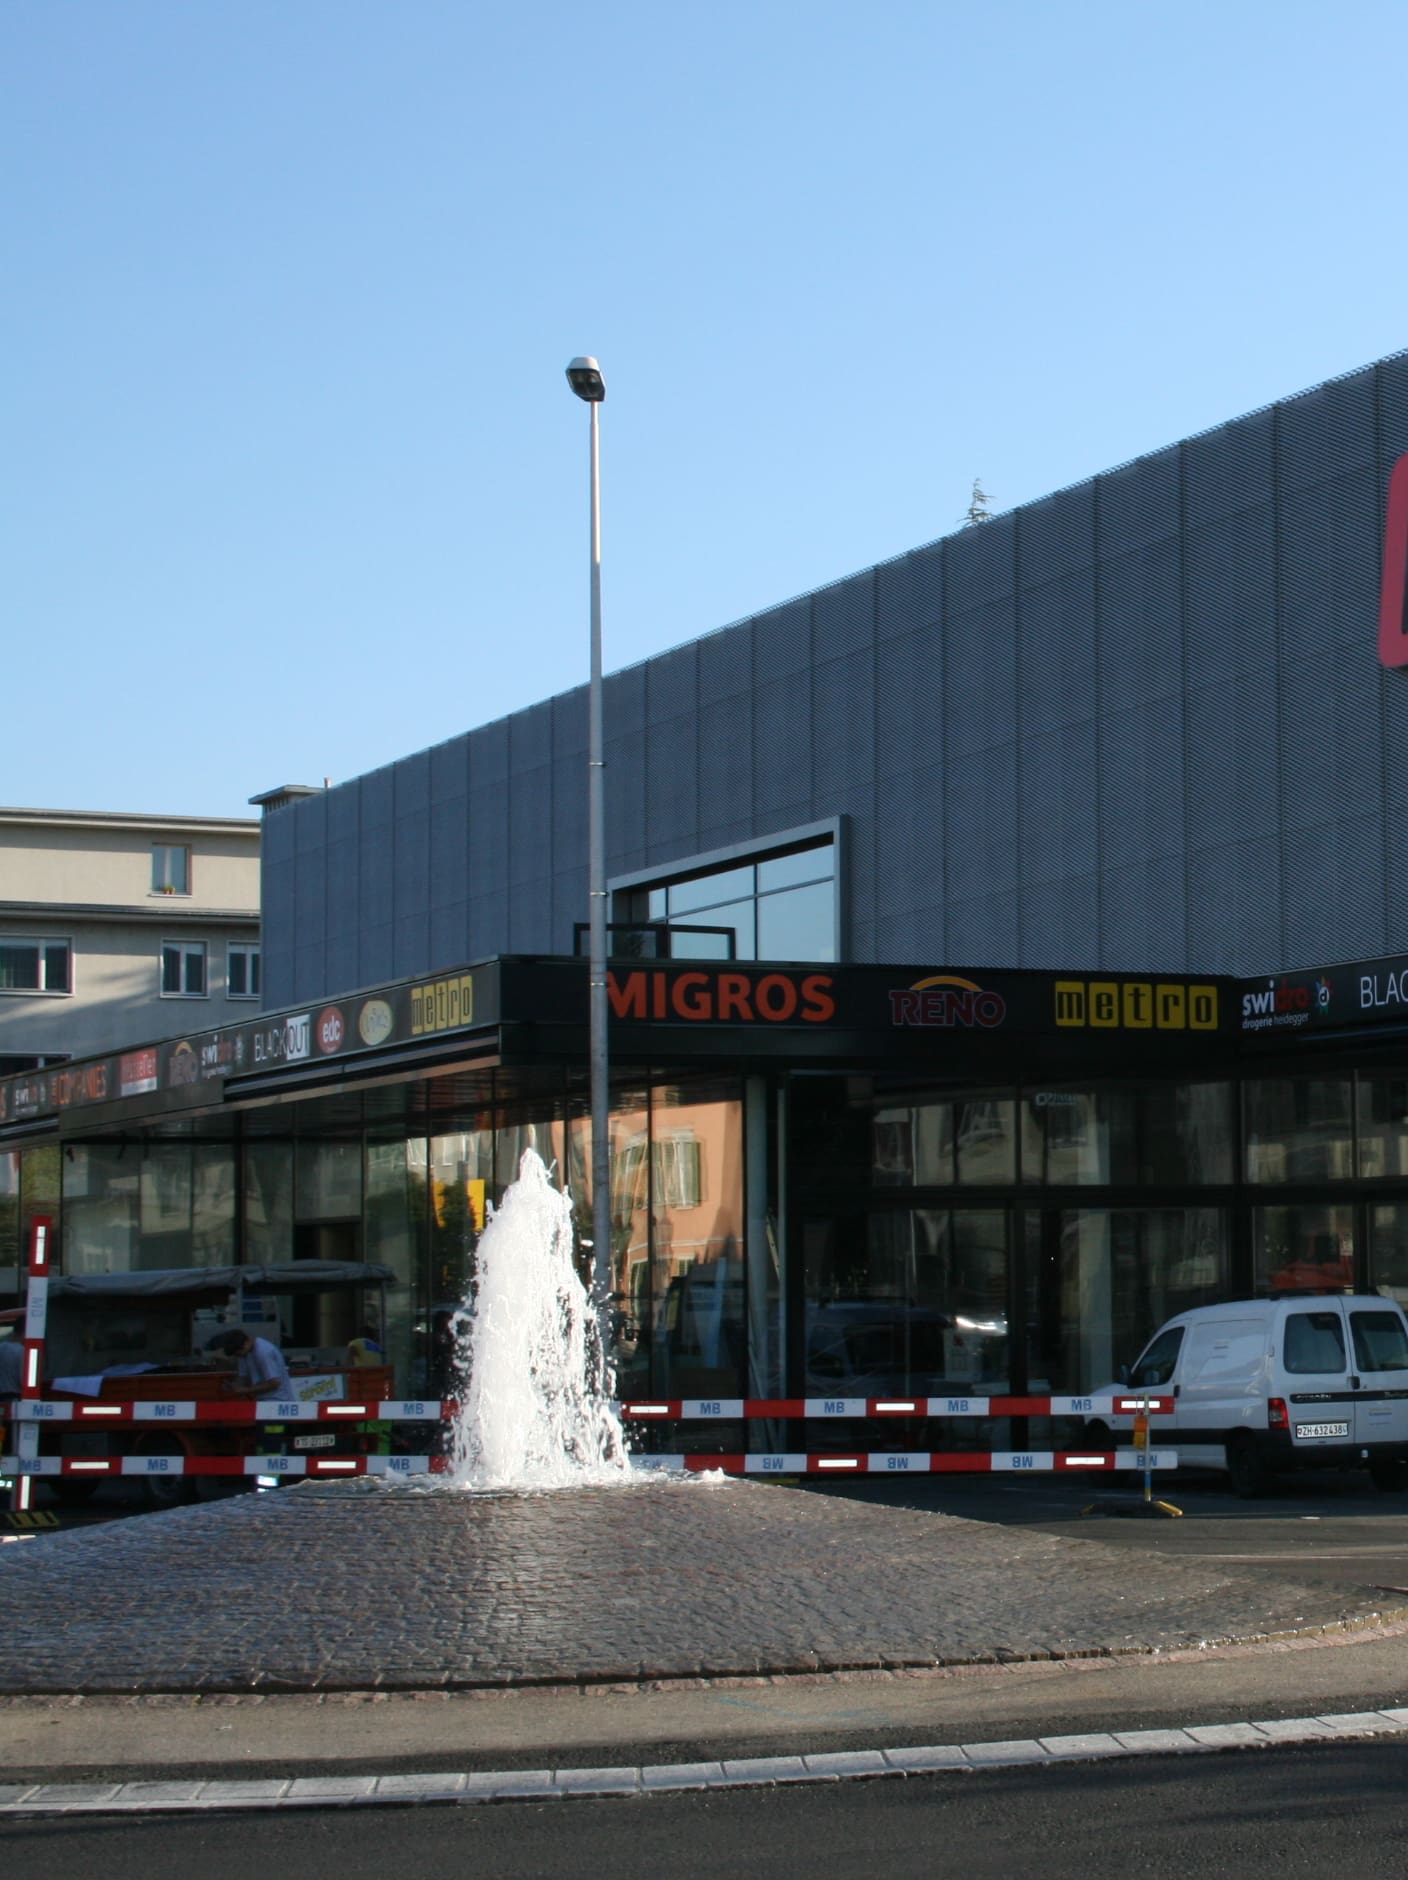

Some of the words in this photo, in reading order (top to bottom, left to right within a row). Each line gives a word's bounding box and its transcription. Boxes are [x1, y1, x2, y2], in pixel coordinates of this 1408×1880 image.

[606, 970, 837, 1023] MIGROS
[412, 982, 471, 1029] metro
[888, 988, 1007, 1029] RENO
[1056, 984, 1215, 1026] metro
[322, 1015, 341, 1043] edc
[1242, 1015, 1273, 1031] drogerie
[201, 1033, 233, 1067] swi
[32, 1404, 54, 1416] MB
[154, 1404, 176, 1417] MB
[278, 1404, 299, 1416] MB
[403, 1403, 424, 1415] MB
[700, 1402, 721, 1415] MB
[824, 1401, 845, 1414] MB
[947, 1399, 968, 1412] MB
[1071, 1398, 1092, 1411] MB
[147, 1458, 169, 1471] MB
[267, 1458, 288, 1471] MB
